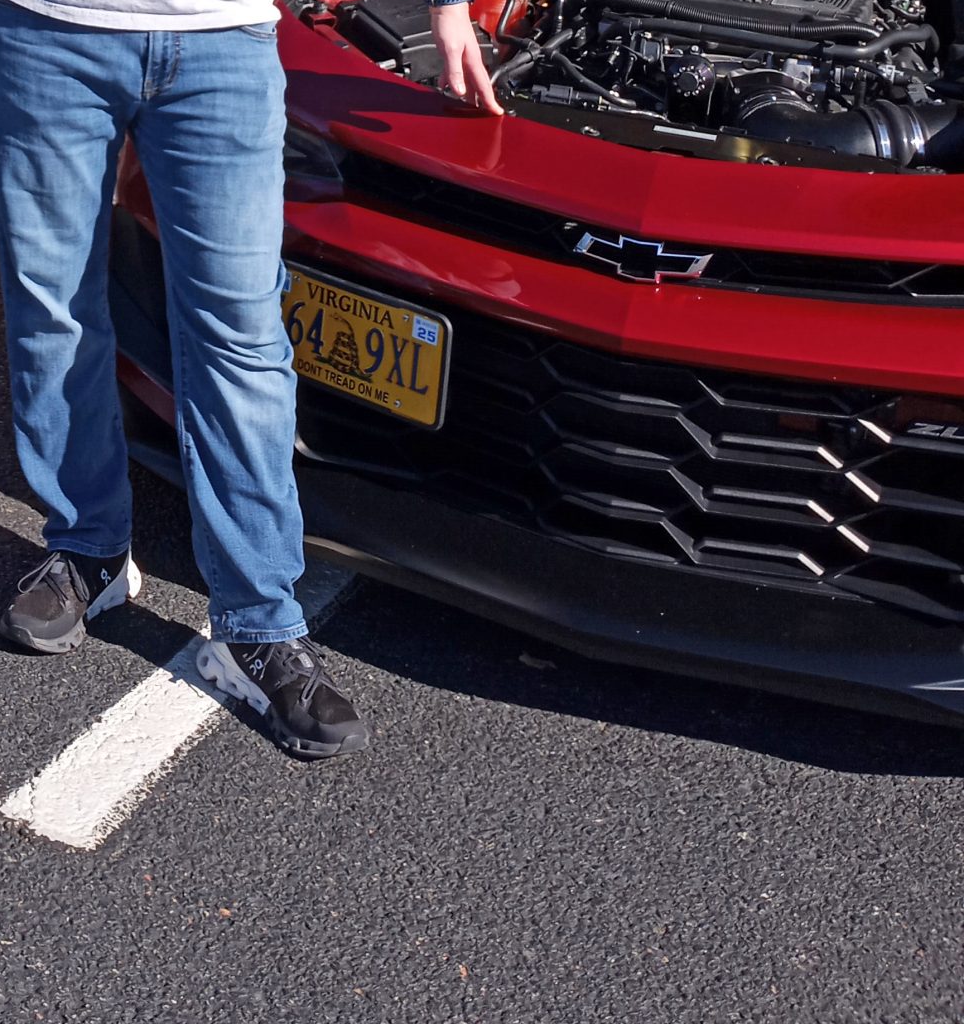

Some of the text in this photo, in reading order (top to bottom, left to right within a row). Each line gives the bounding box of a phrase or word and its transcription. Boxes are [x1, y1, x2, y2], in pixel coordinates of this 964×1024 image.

[283, 299, 324, 356] 64
[307, 282, 395, 329] VIRGINIA
[417, 327, 436, 343] 25
[298, 359, 390, 404] DONT TREAD ON ME
